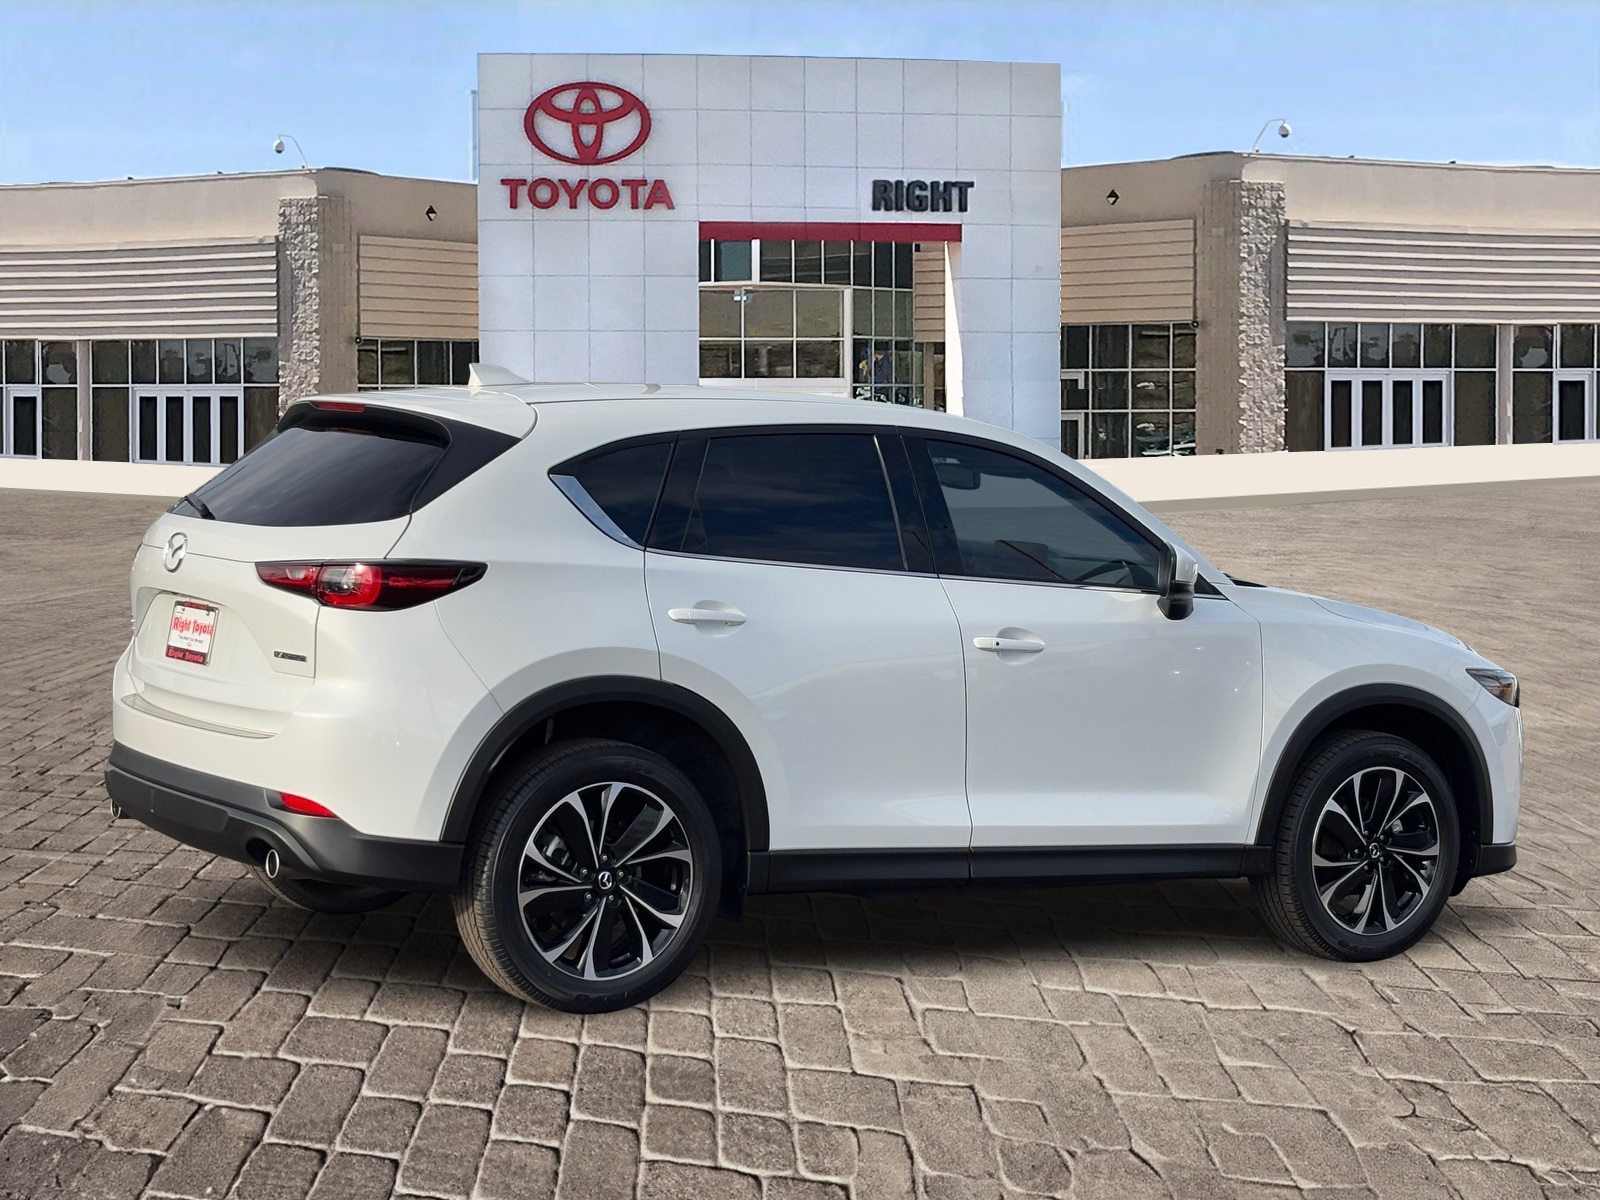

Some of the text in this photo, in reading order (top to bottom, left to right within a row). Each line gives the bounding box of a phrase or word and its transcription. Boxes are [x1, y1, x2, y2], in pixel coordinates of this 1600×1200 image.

[500, 178, 675, 209] TOYOTA
[872, 180, 974, 212] RIGHT
[173, 616, 213, 636] Right Toyota
[168, 648, 204, 663] Right Toyota
